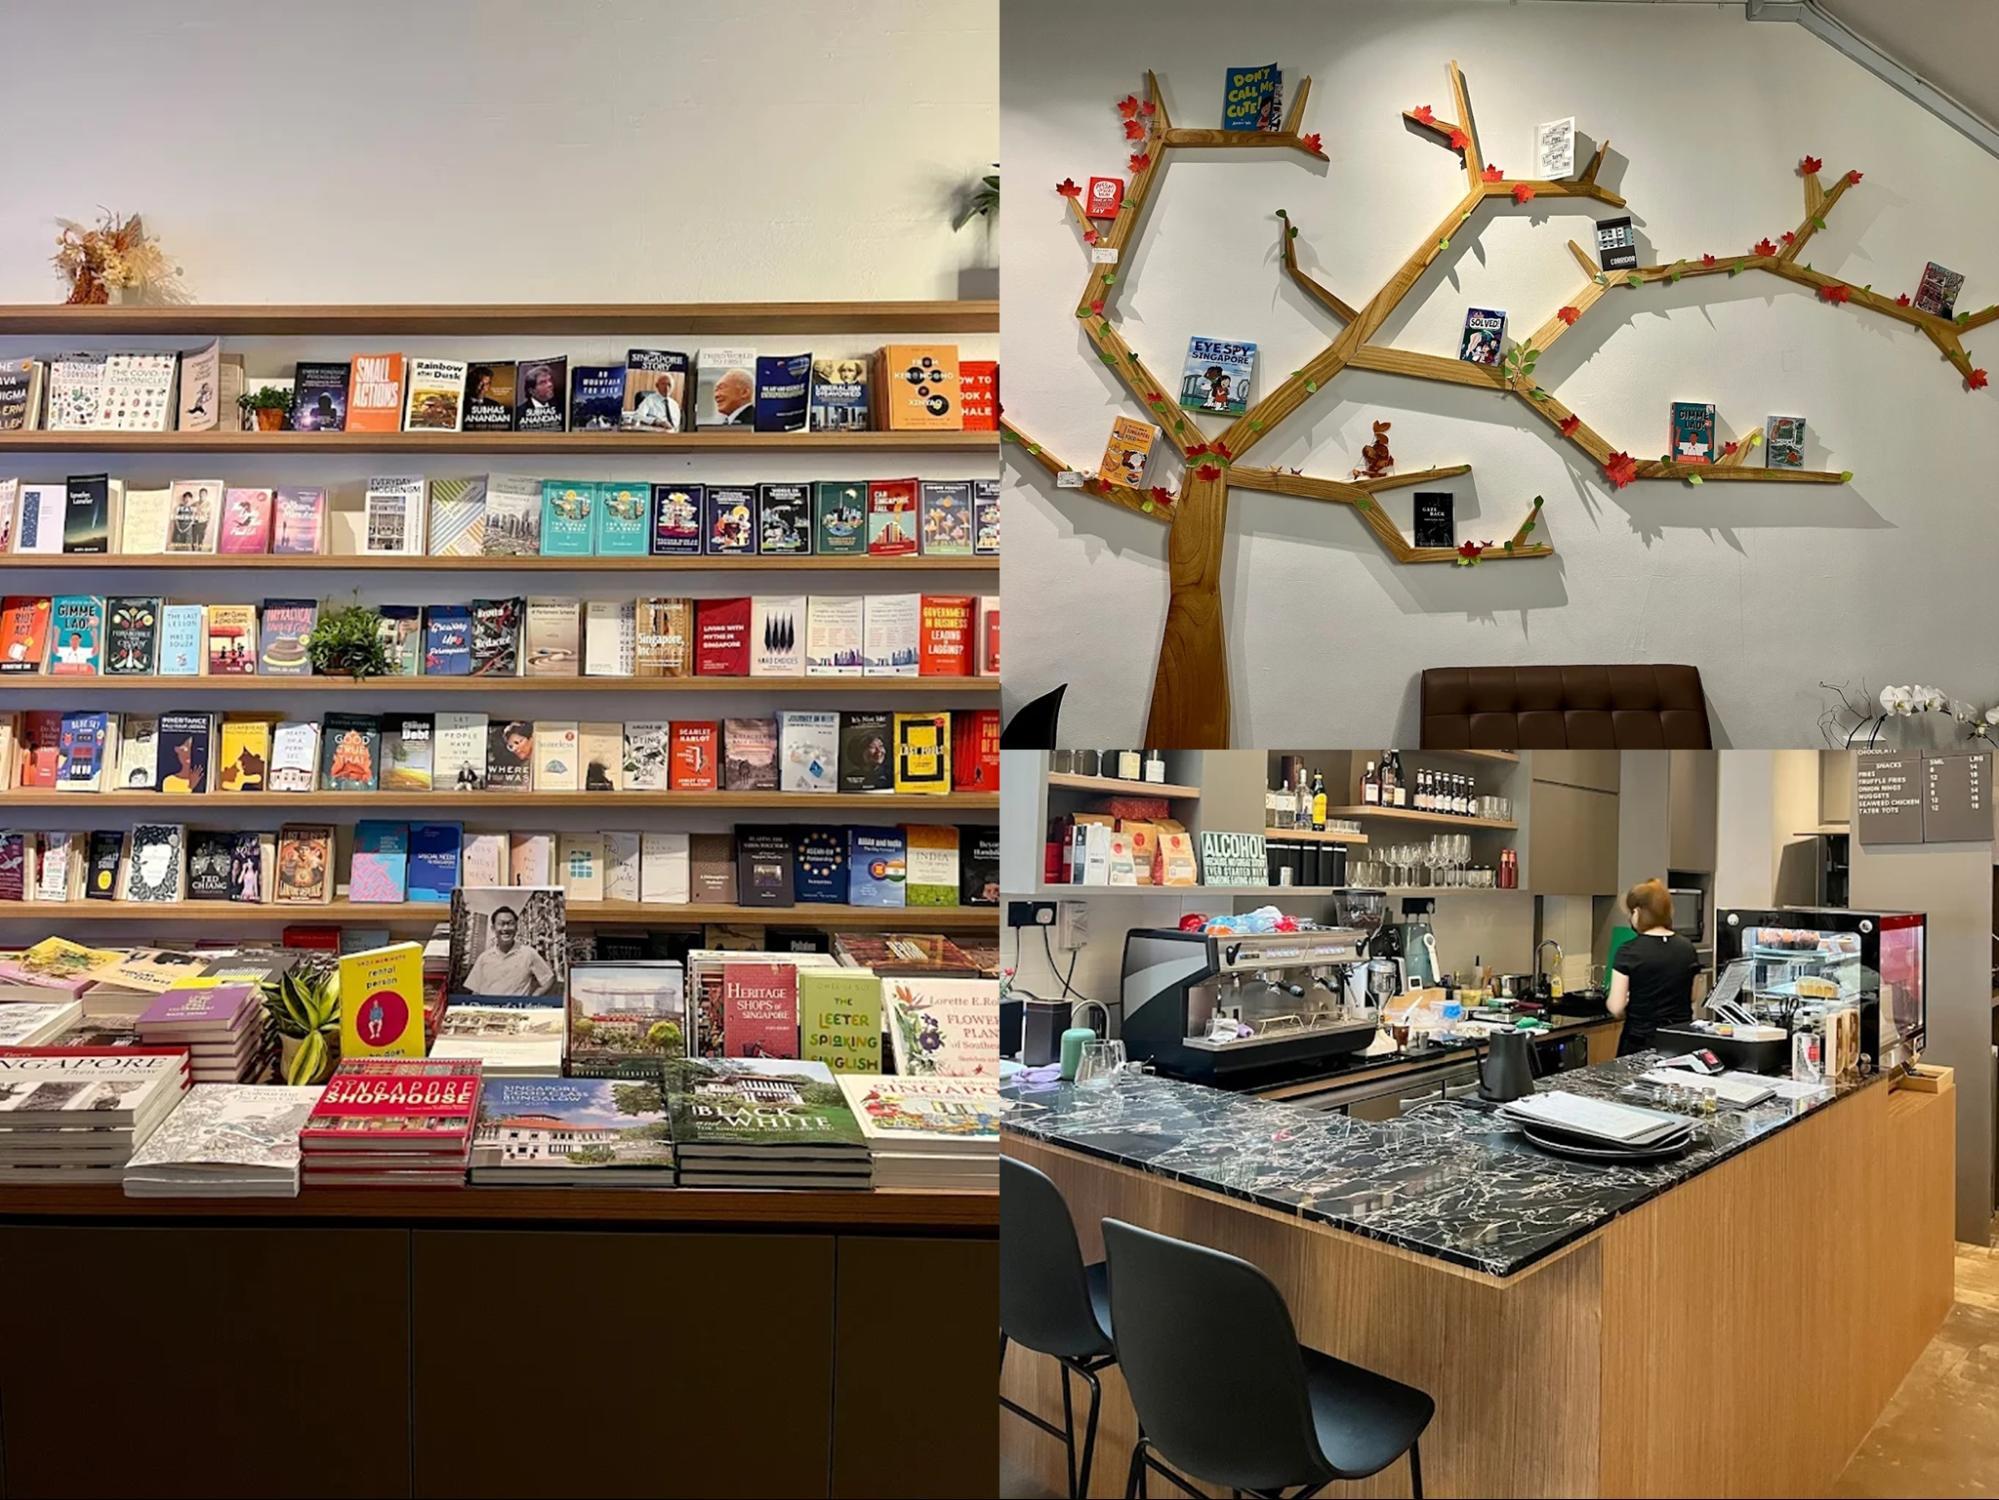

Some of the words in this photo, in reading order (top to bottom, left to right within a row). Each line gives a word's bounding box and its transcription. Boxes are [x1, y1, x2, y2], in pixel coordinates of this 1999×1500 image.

[1234, 68, 1270, 87] DON'T
[1229, 86, 1258, 102] CALL
[1260, 80, 1274, 92] ME
[1227, 96, 1262, 118] CUTE!
[1470, 318, 1500, 328] SOLVED!
[1194, 341, 1221, 354] EYE
[1224, 343, 1250, 356] SPY
[632, 353, 684, 364] SINGAPORE
[1192, 352, 1250, 364] SINGAPORE
[356, 358, 390, 382] SMALL
[416, 362, 464, 372] Rainbow
[642, 362, 670, 372] STORY
[434, 370, 461, 381] Dusk
[353, 382, 398, 408] ACTIONS
[471, 406, 504, 414] SUBHAS
[526, 408, 556, 416] SUBHAS
[465, 414, 511, 422] ANANDAN
[519, 414, 562, 424] ANANDAN
[371, 478, 411, 488] EVERYDAY
[874, 497, 909, 506] SINGAPORE
[58, 604, 96, 616] GIMME
[923, 606, 969, 618] GOVERNMENT
[638, 633, 684, 648] Singapore,
[402, 721, 430, 729] Climate
[334, 734, 370, 745] GOOD
[402, 730, 430, 740] Debt
[488, 766, 530, 774] WHERE
[504, 774, 530, 782] WAS
[1204, 834, 1266, 858] ALCOHOL
[916, 852, 949, 862] INDIA
[192, 881, 227, 890] CHIANG
[368, 966, 396, 978] rental
[366, 977, 398, 990] person
[728, 983, 786, 999] HERITAGE
[737, 1001, 774, 1010] SHOPS
[834, 997, 854, 1006] THE
[930, 996, 969, 1006] Lorette
[743, 1010, 789, 1020] SINGAPORE
[818, 1013, 868, 1029] LEETER
[810, 1033, 878, 1052] SPIAKING
[810, 1056, 878, 1070] SINGLISH
[331, 1080, 475, 1096] SINGAPORE
[324, 1092, 472, 1104] SHOPHOUSE
[698, 1105, 798, 1117] BLACK
[724, 1116, 832, 1128] WHITE
